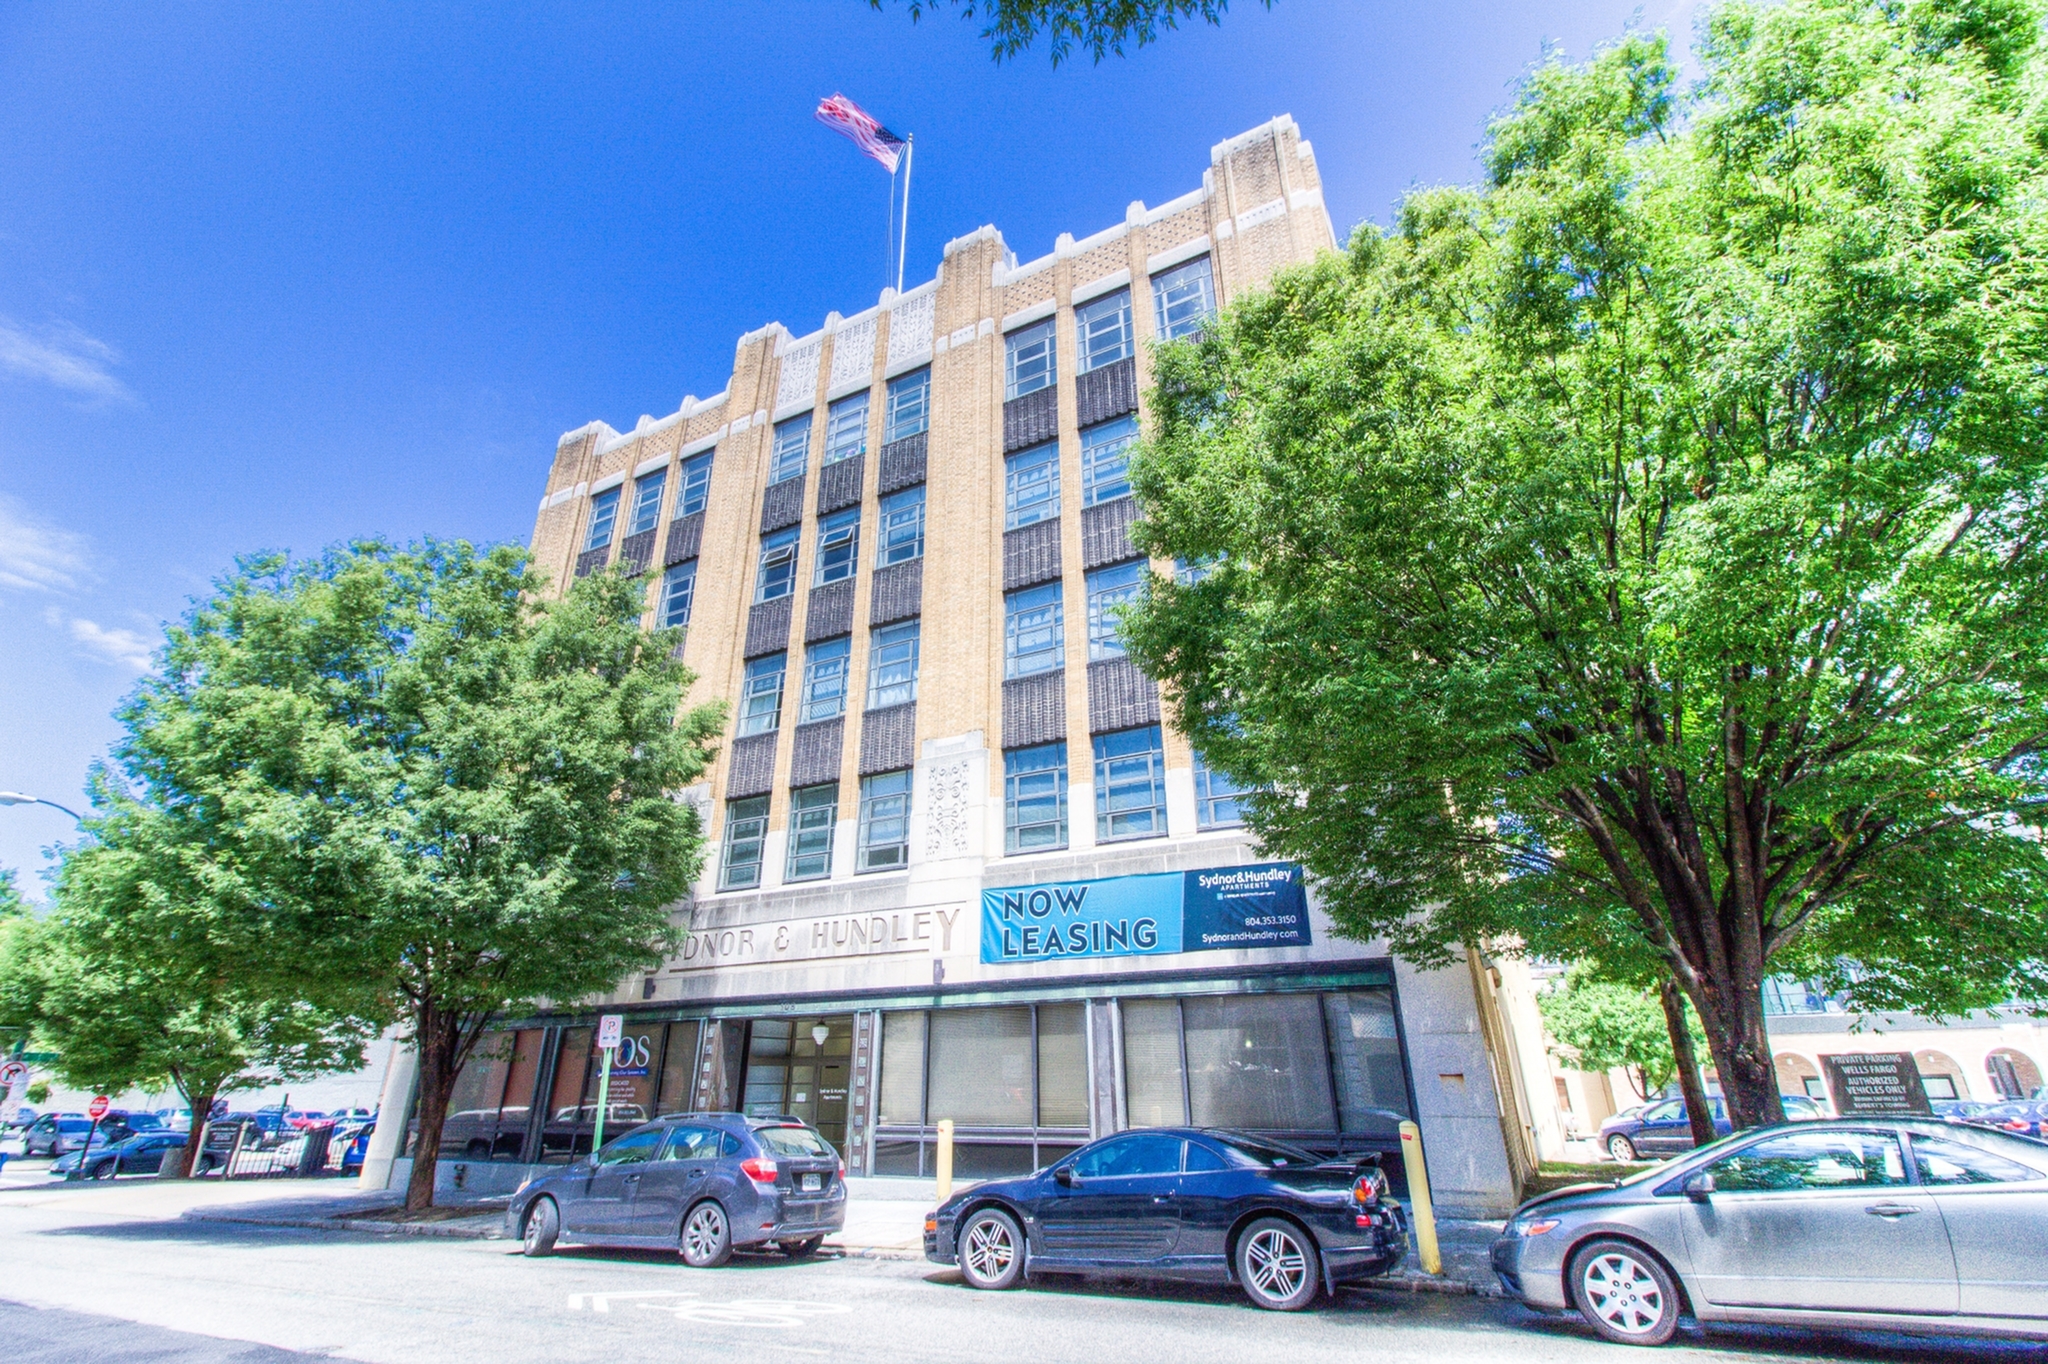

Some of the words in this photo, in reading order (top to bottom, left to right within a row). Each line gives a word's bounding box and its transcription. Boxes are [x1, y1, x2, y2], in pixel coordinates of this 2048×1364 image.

[1199, 868, 1292, 888] Sydnor&Hundley
[1220, 881, 1270, 891] APARTMENTS
[1003, 885, 1090, 921] NOW
[1245, 915, 1297, 926] 804.353.3150
[774, 925, 790, 952] &
[811, 908, 960, 951] HUNDLEY
[1003, 917, 1158, 957] LEASING
[1202, 930, 1299, 944] SydnorandHundleycom
[1830, 1055, 1864, 1064] PRIVATE
[1866, 1054, 1902, 1063] PARKING
[1842, 1066, 1869, 1074] WELLS
[1870, 1065, 1898, 1073] FARGO
[1848, 1076, 1899, 1085] AUTHORIZED
[1845, 1086, 1884, 1095] VEHICLES
[1885, 1085, 1906, 1094] ONLY
